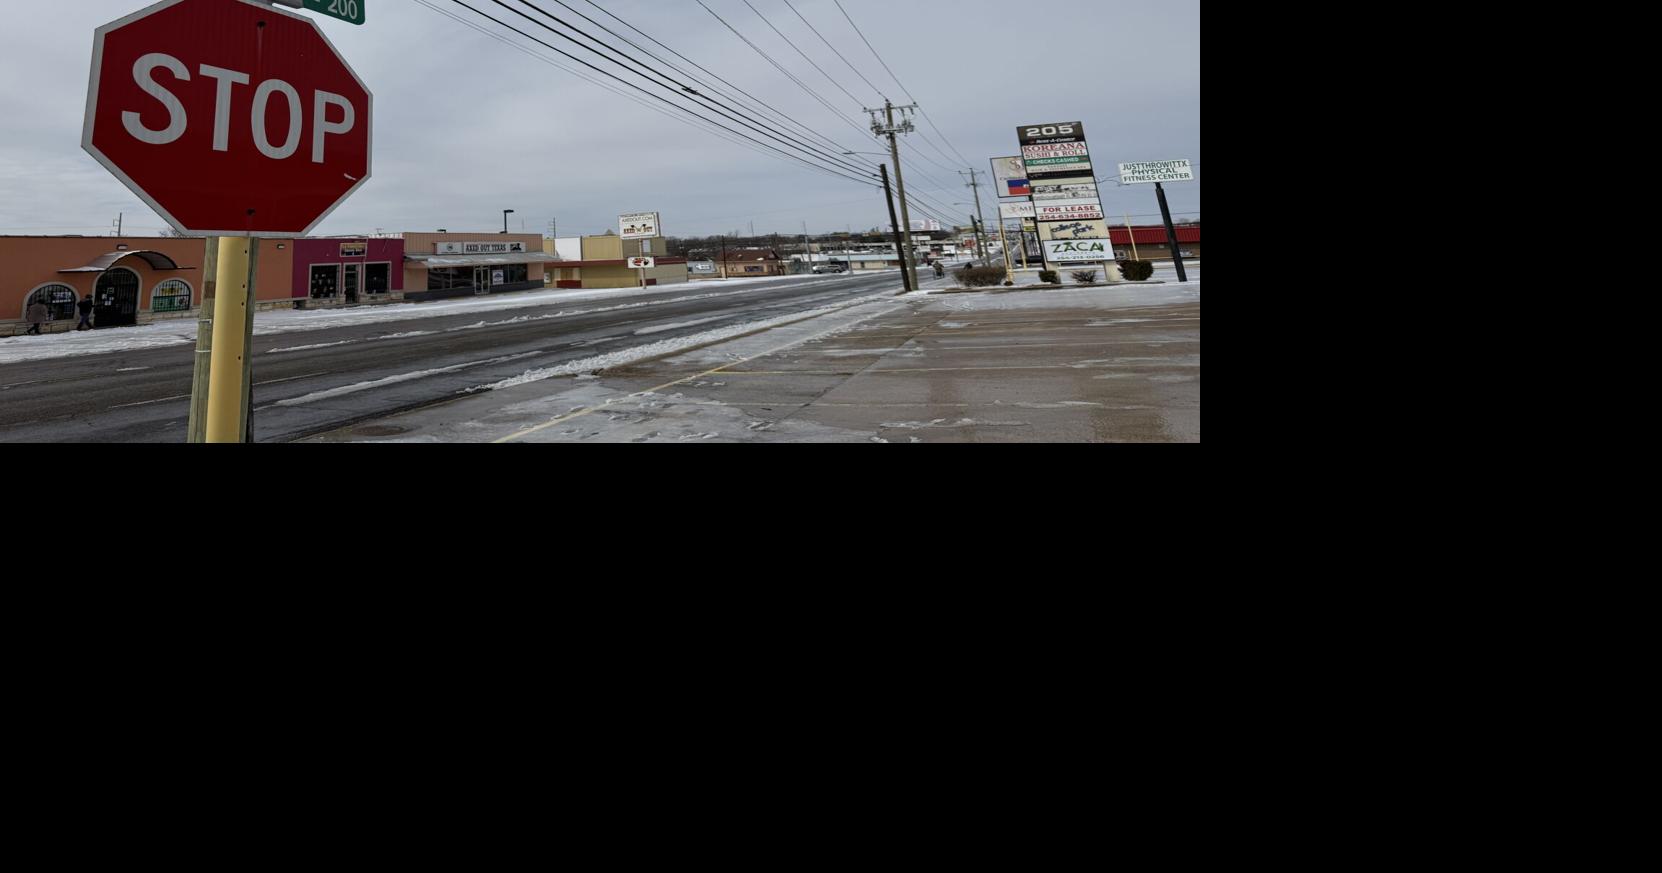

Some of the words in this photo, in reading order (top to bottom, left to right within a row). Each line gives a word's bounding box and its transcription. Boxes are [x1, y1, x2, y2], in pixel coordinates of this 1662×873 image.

[328, 0, 358, 20] 200
[122, 53, 355, 163] STOP
[1026, 125, 1074, 137] 205
[1023, 142, 1086, 153] KOREANA
[1025, 151, 1051, 159] SUSHI
[1123, 160, 1188, 170] JUSTTHROWITTX
[1131, 167, 1178, 175] PHYSICAL
[1157, 172, 1190, 180] CENTER
[1072, 224, 1095, 237] park
[466, 244, 479, 252] AXED
[480, 243, 491, 252] OUT
[491, 243, 507, 251] TEXAS
